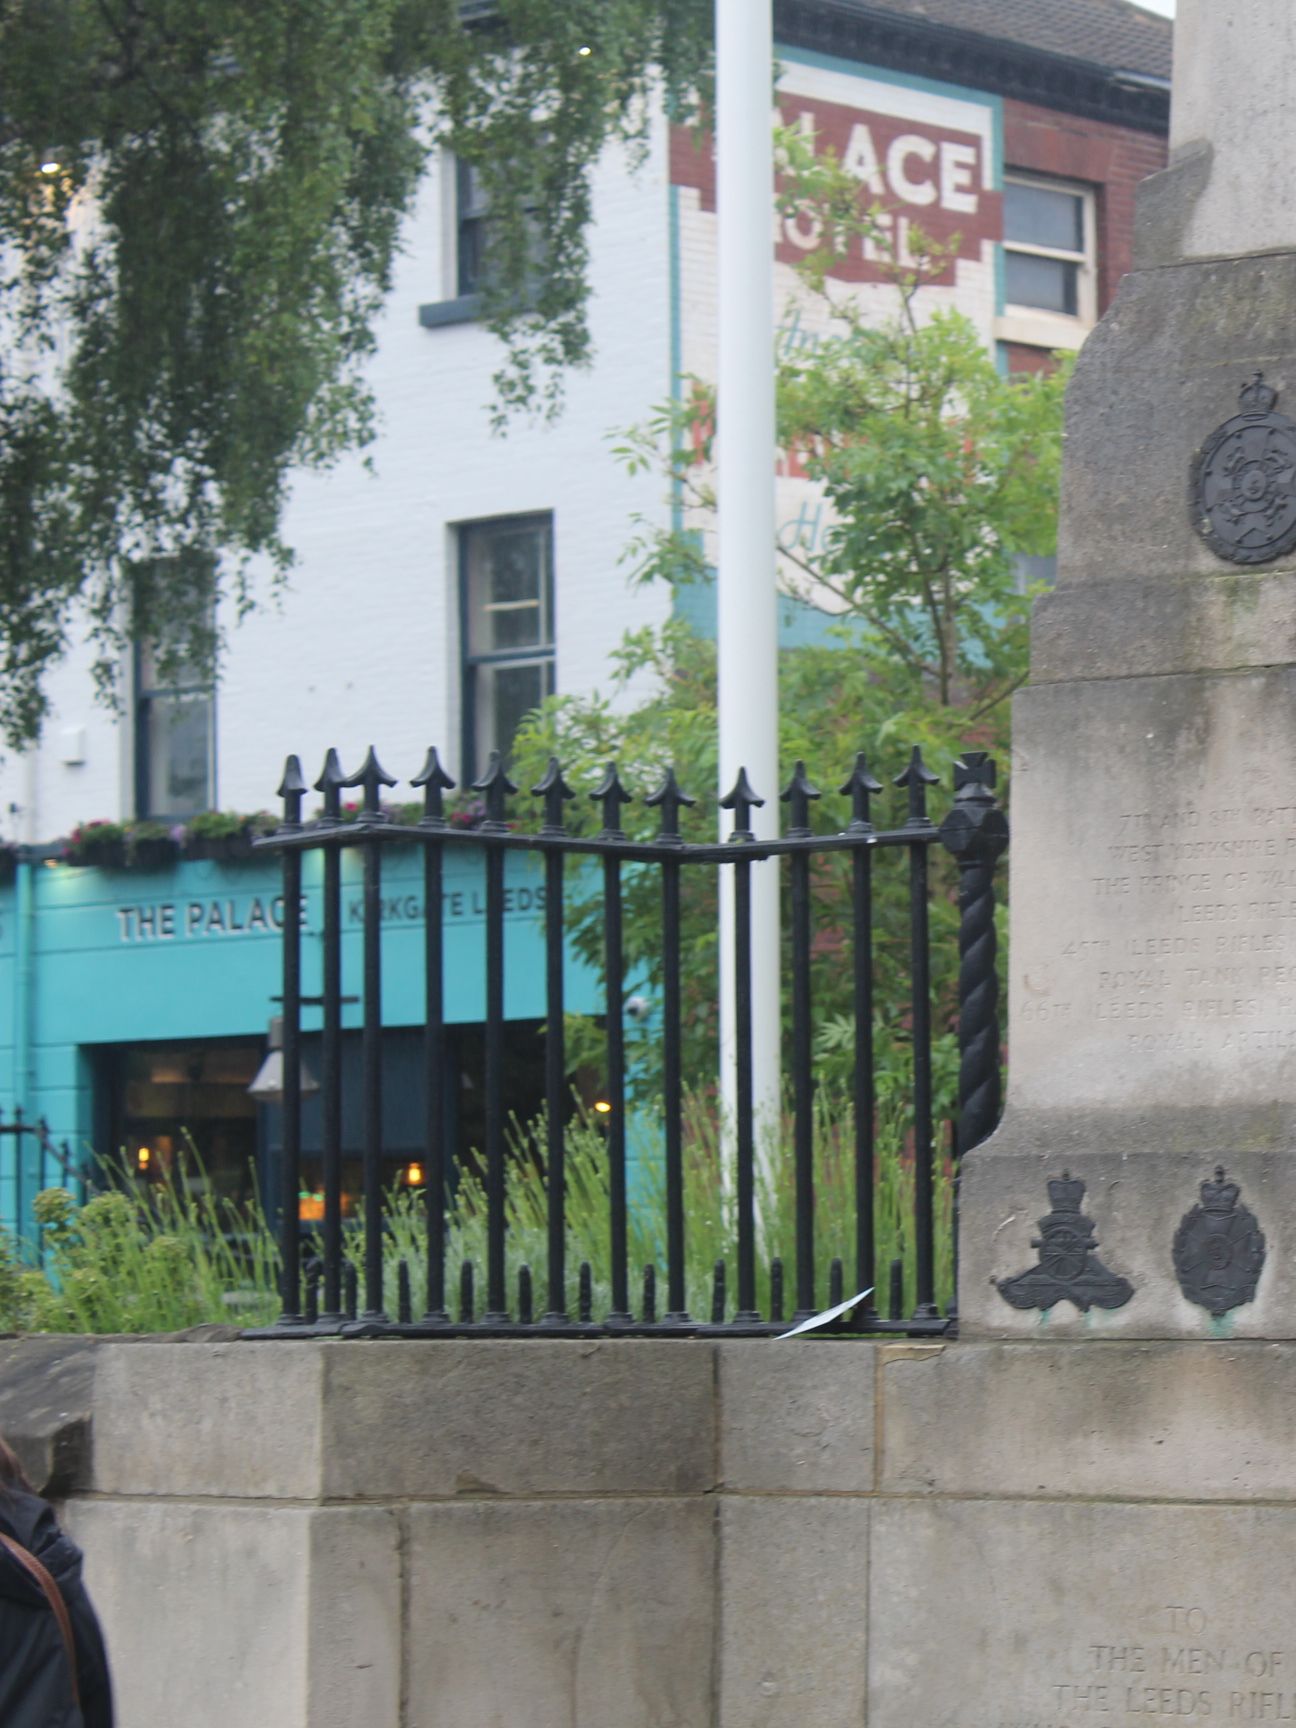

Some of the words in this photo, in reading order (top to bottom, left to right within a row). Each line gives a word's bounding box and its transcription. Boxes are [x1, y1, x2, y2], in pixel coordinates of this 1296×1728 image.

[770, 106, 979, 215] LACE
[1160, 810, 1201, 829] AND
[1107, 842, 1165, 863] WEST
[1168, 838, 1277, 861] YORKSHIRE
[1091, 876, 1132, 896] THE
[1138, 872, 1212, 895] PRINCE
[1222, 870, 1250, 891] OF
[115, 904, 176, 942] THE
[184, 893, 309, 937] PALACE
[472, 886, 549, 916] LEDS
[1177, 903, 1239, 923] LEEDS
[1098, 968, 1172, 990] ROYAL
[1185, 965, 1248, 987] TANK
[1127, 1030, 1204, 1053] ROYAL
[1164, 1604, 1209, 1635] TO
[1088, 1642, 1147, 1675] THE
[1160, 1645, 1227, 1676] MEN
[1244, 1649, 1286, 1679] OF
[1051, 1683, 1111, 1714] THE
[1124, 1685, 1214, 1718] LEEDS
